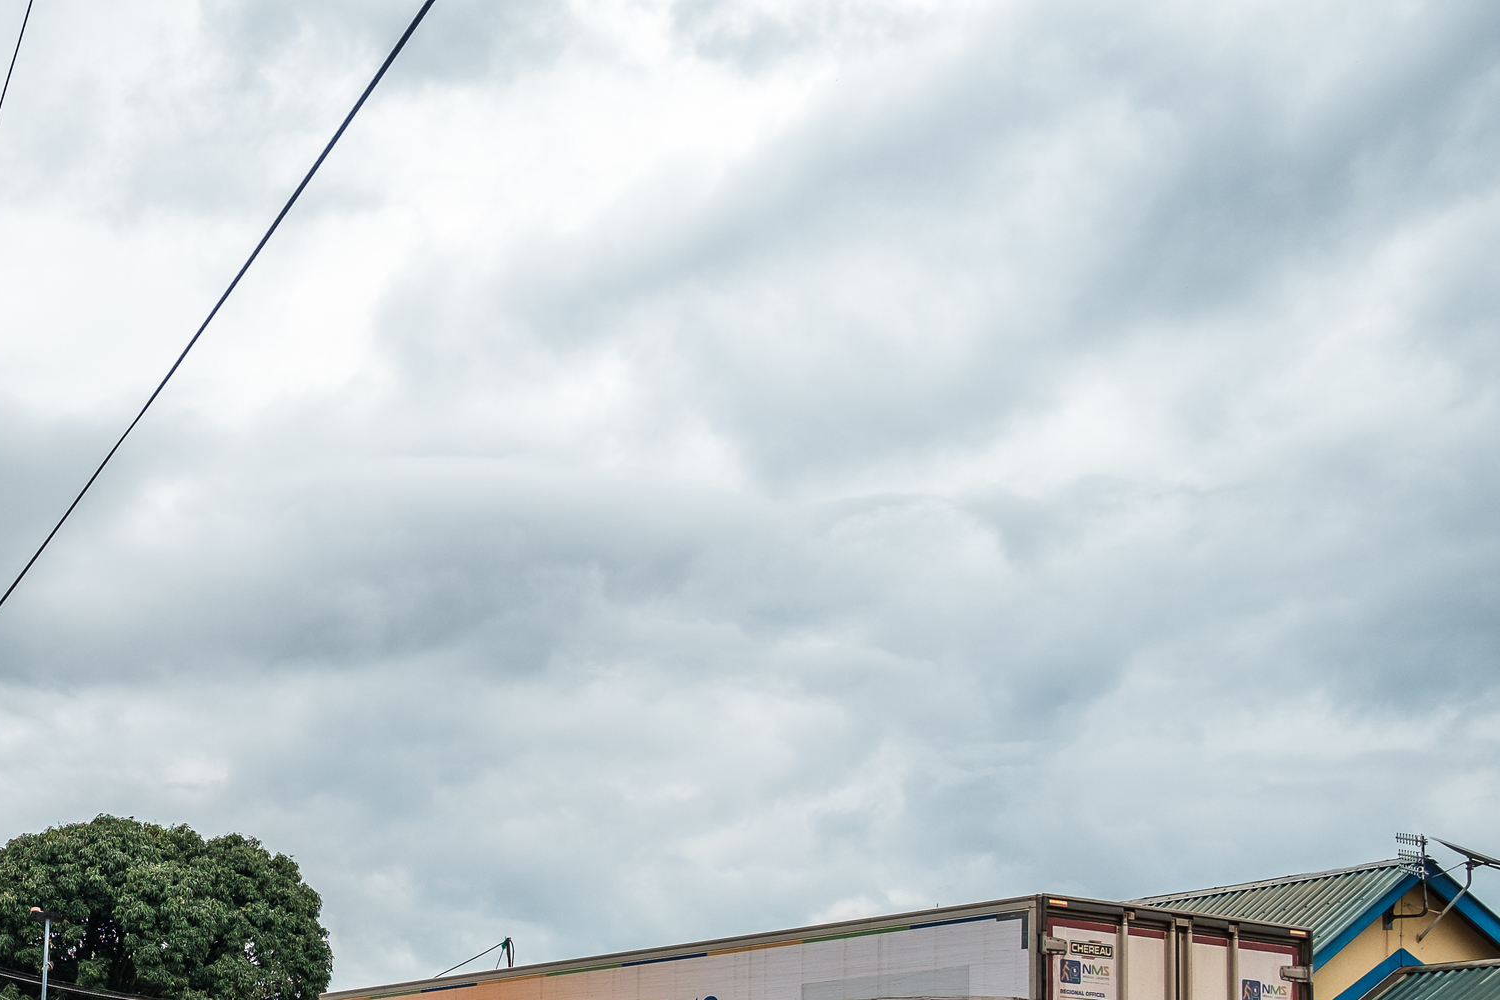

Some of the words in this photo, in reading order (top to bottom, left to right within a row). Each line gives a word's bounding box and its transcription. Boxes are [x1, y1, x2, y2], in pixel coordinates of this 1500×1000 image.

[1071, 943, 1112, 957] CHEREAU
[1082, 963, 1110, 977] NMS
[1060, 988, 1085, 997] REGIONAL
[1085, 991, 1106, 999] OFFICES
[1262, 983, 1287, 996] NMS
